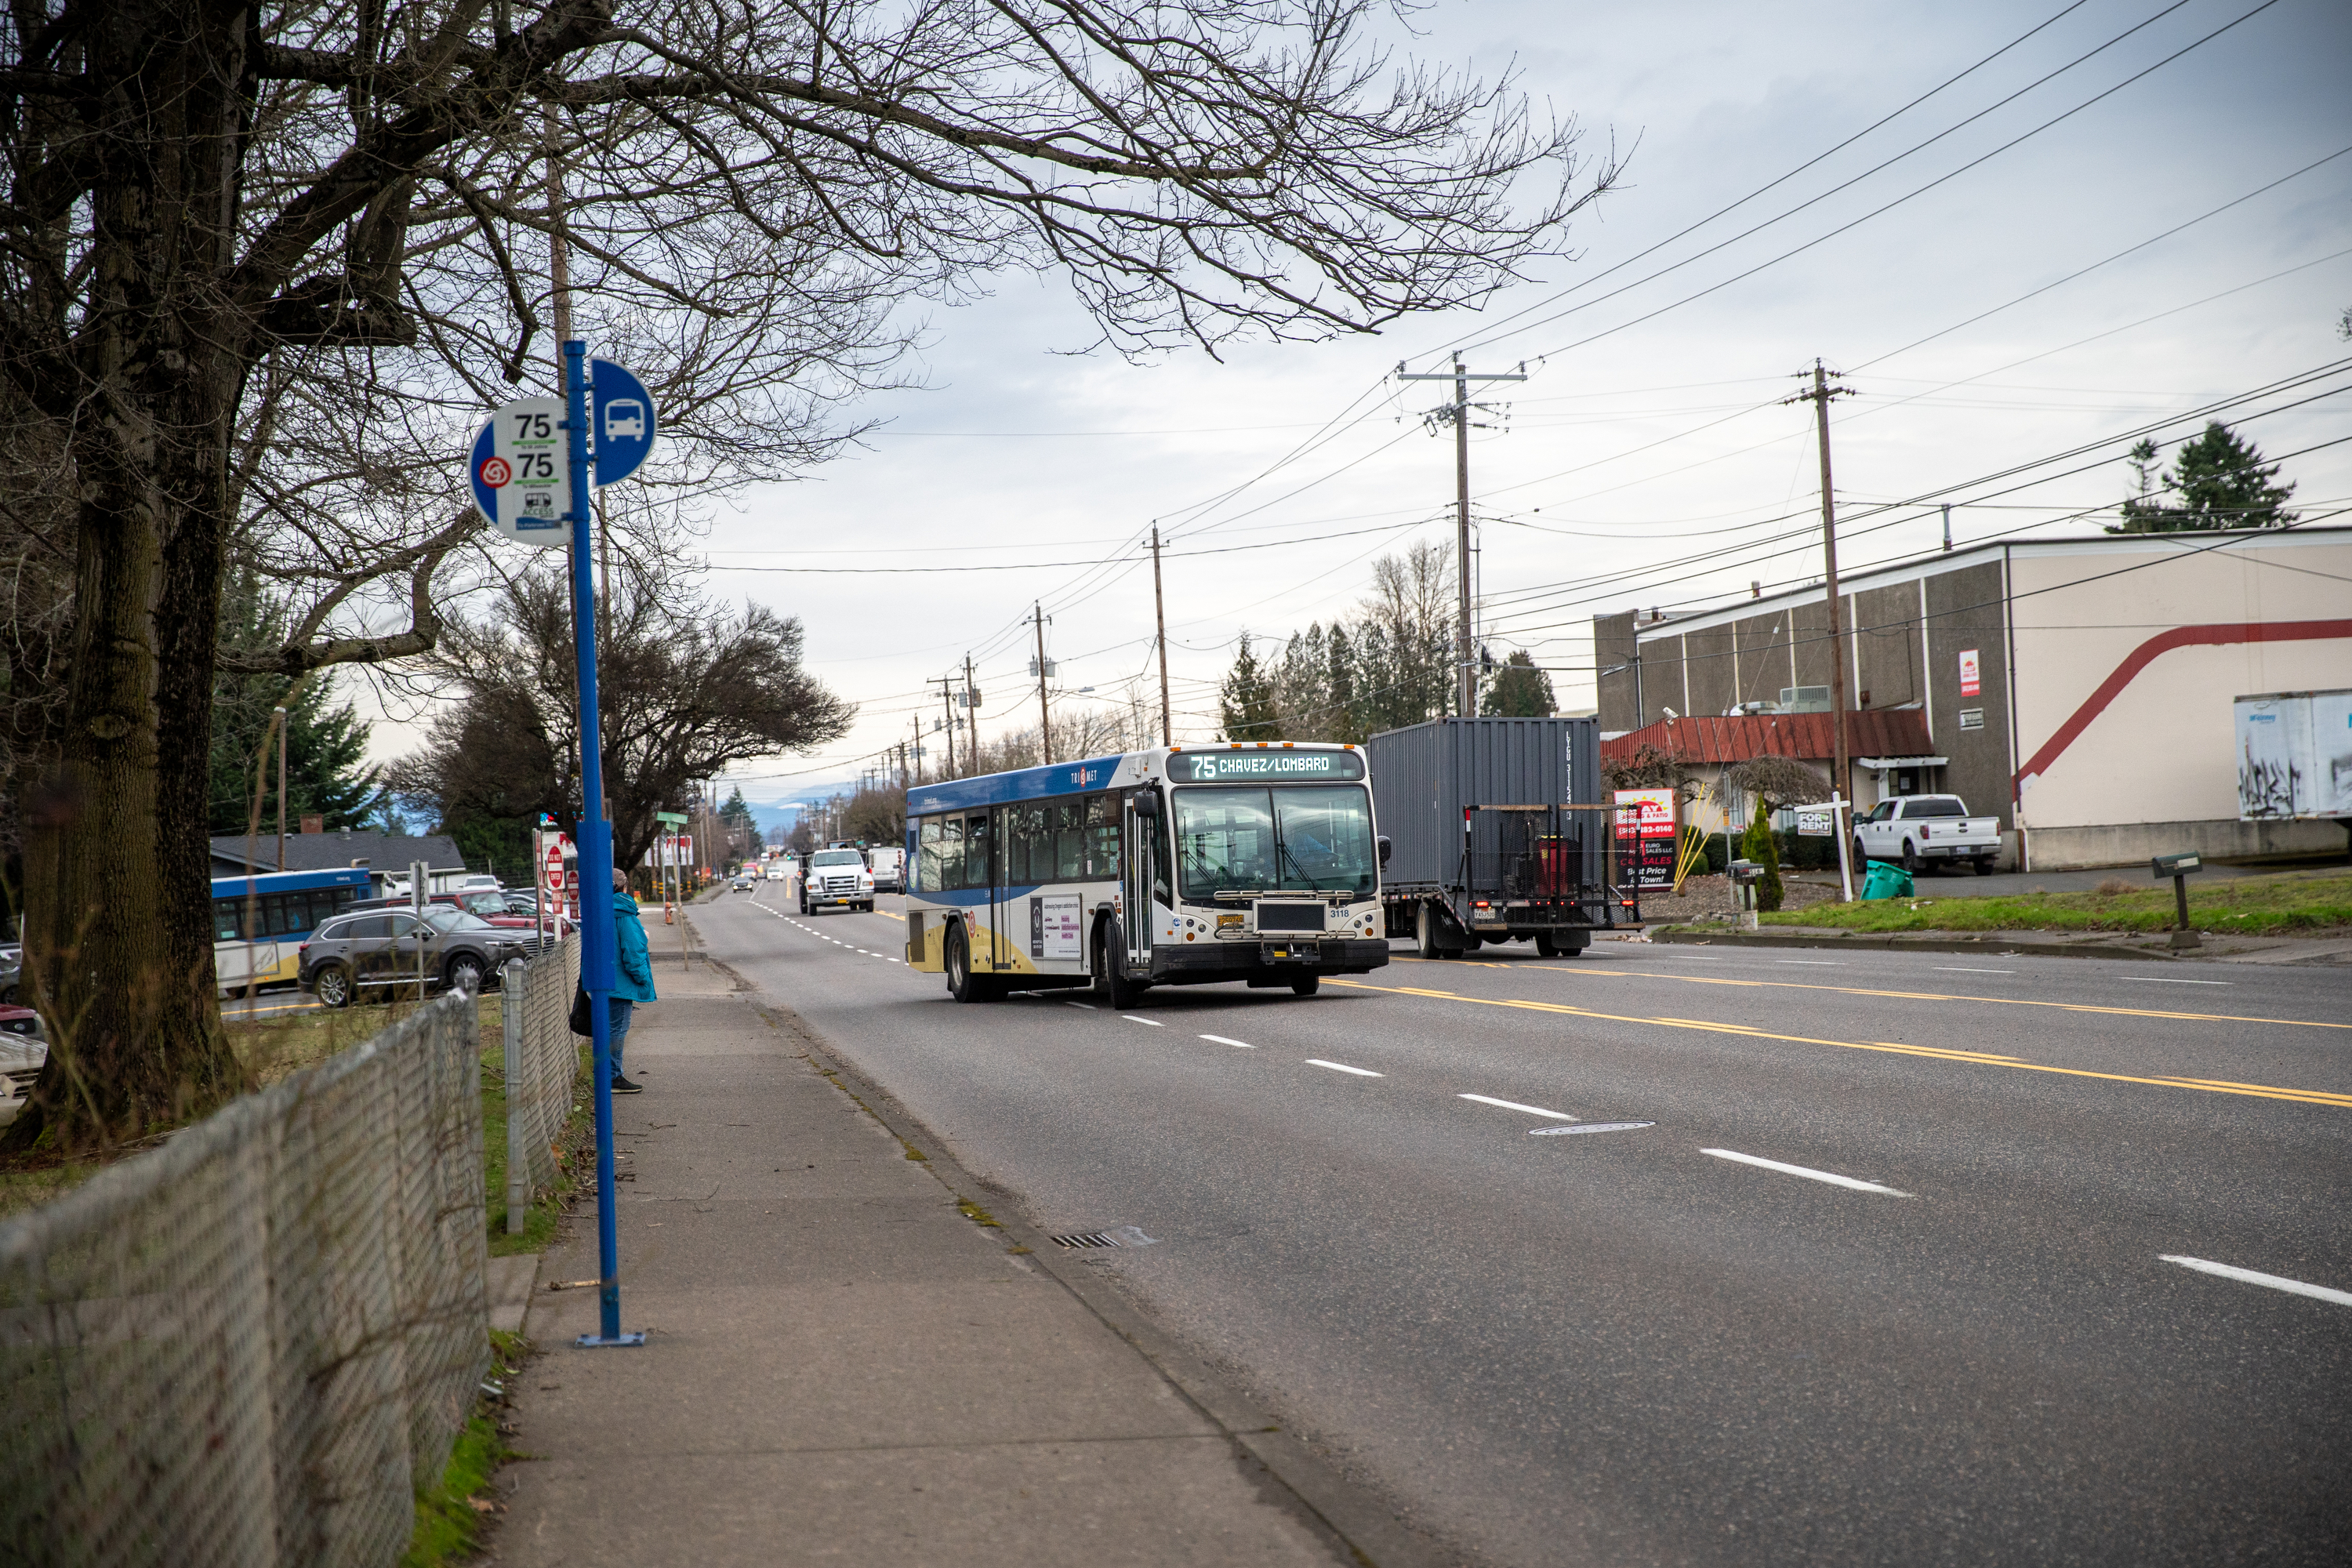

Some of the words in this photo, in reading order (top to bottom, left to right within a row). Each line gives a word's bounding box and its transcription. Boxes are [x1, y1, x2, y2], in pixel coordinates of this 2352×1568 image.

[515, 413, 551, 439] 75
[517, 452, 554, 478] 75
[522, 507, 554, 516] ACCESS
[1190, 755, 1217, 779] 75
[1219, 757, 1330, 773] CHAVEZ/LOMBARD
[1071, 772, 1080, 784] TRI
[1086, 769, 1098, 782] MET
[1799, 813, 1823, 822] FOR
[1799, 821, 1830, 830] RENT
[1642, 856, 1672, 866] SALES
[1330, 909, 1349, 918] 3118
